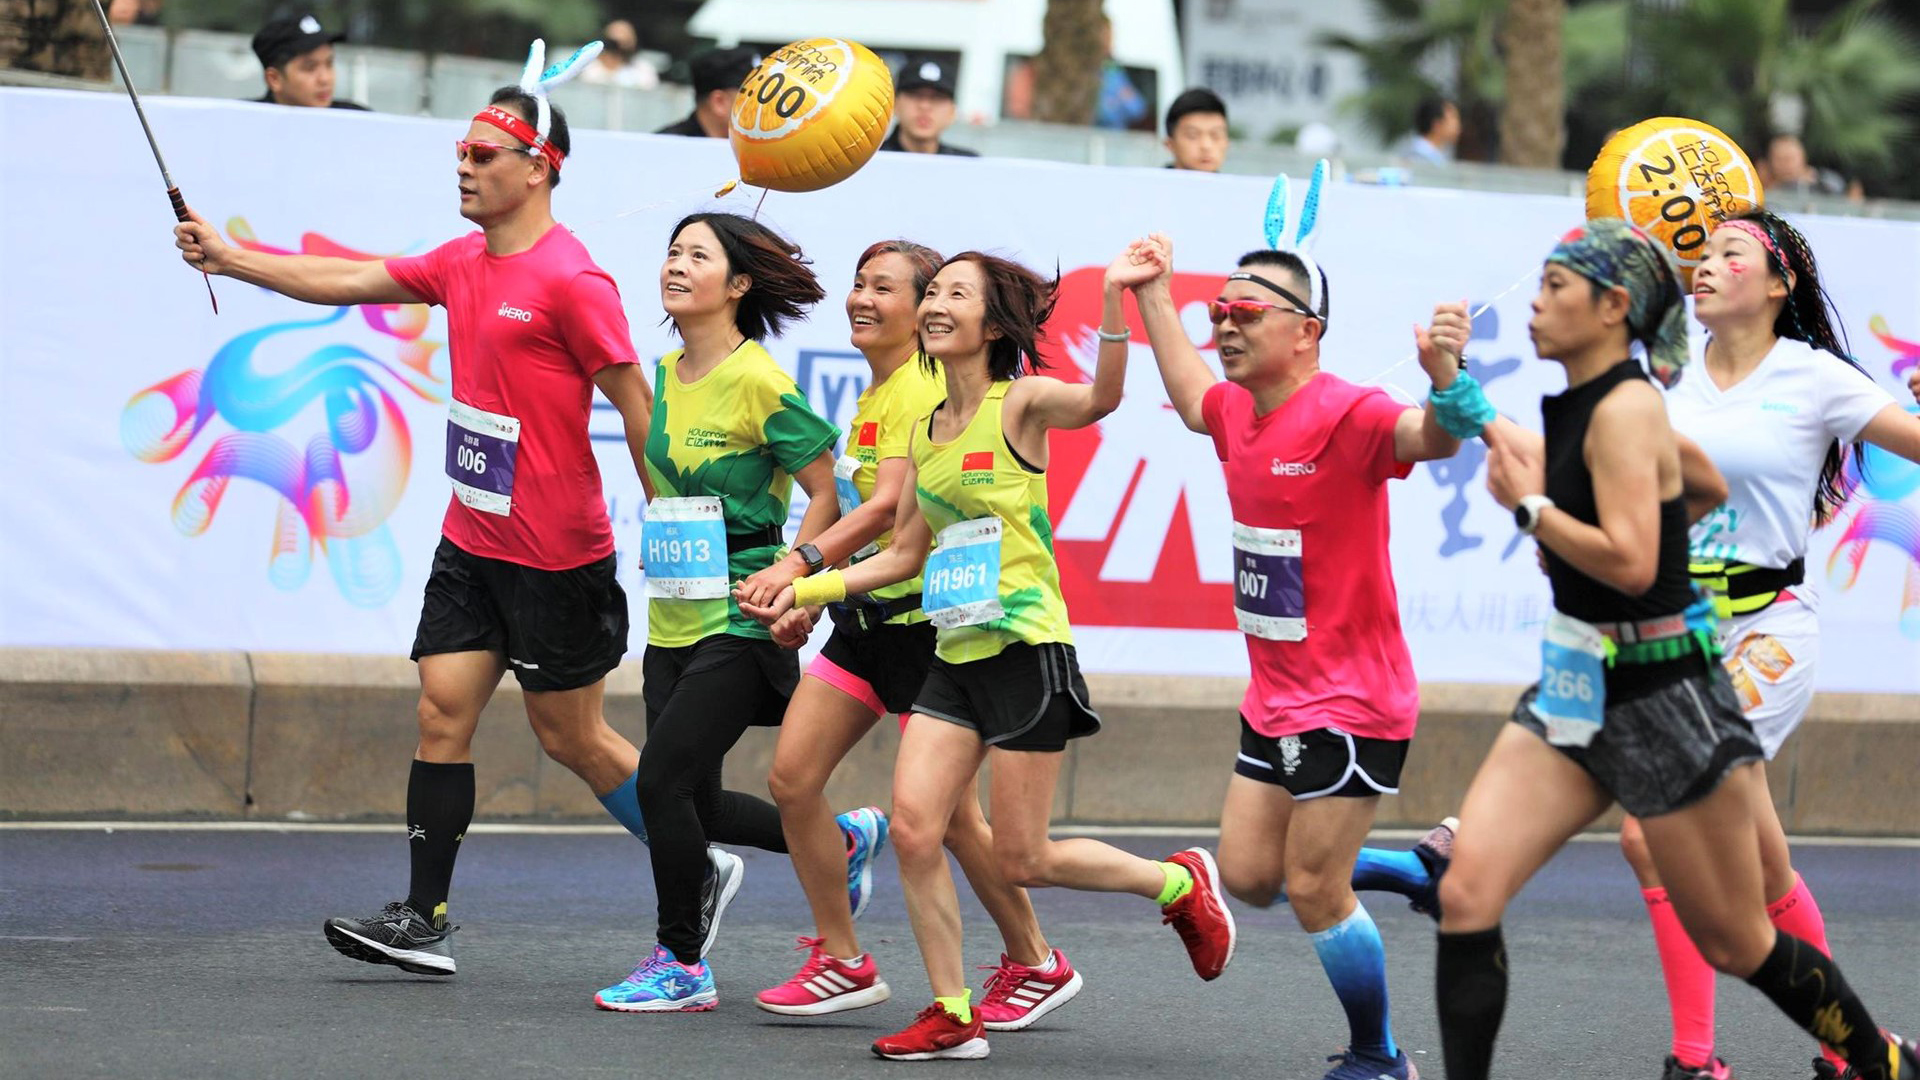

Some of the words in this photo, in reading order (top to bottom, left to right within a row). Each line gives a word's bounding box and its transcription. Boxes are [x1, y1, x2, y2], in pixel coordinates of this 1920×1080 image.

[1639, 154, 1707, 252] 2:00
[457, 444, 487, 475] 006
[648, 538, 711, 563] H1913
[928, 562, 988, 596] H1961
[1239, 569, 1269, 600] 007
[1544, 663, 1593, 702] 266
